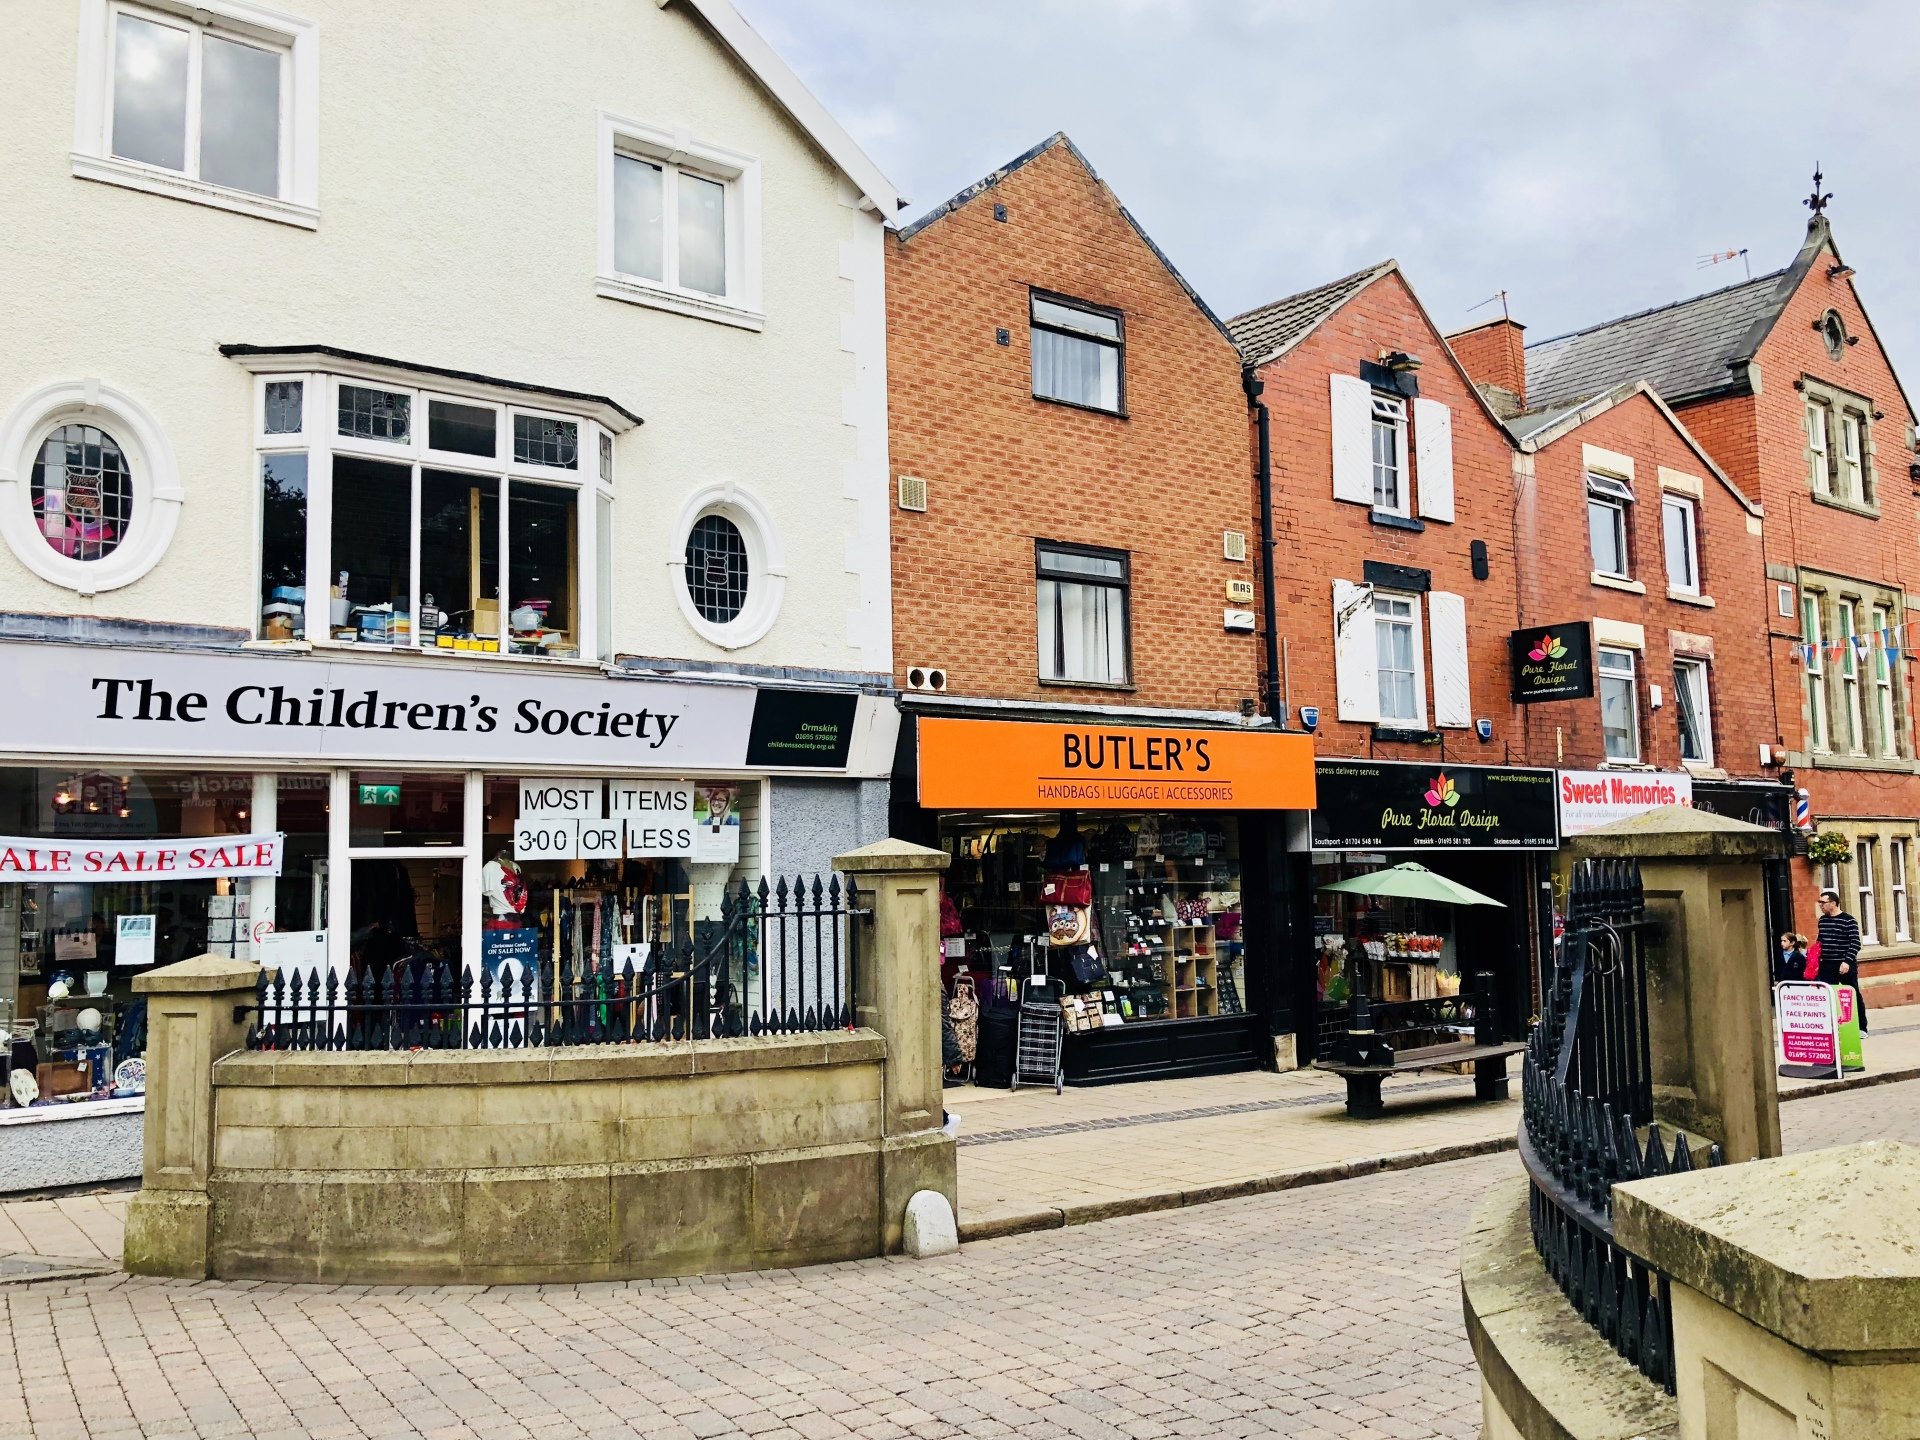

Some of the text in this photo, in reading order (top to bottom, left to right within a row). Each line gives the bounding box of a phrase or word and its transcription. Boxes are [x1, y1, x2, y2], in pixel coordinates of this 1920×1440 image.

[1522, 660, 1577, 676] Pure Floral
[1534, 674, 1566, 685] Design
[92, 679, 679, 748] The Children's Society
[801, 723, 838, 733] Ormskirk
[795, 733, 814, 741] 01695
[767, 741, 835, 751] childrenssociety.org.uk
[1064, 734, 1210, 771] BUTLER'S
[1336, 767, 1358, 777] delivery
[1360, 768, 1380, 776] service
[1038, 785, 1233, 800] HANDBAGS LUGGAGE ACCESSORIES
[1562, 776, 1675, 804] Sweet Memories
[524, 788, 687, 811] MOST ITEMS
[1382, 808, 1500, 831] Pure Floral Design
[583, 830, 617, 850] OR
[631, 829, 691, 849] LESS
[1315, 838, 1340, 846] Southport
[0, 843, 273, 872] ALE SALE SALE
[1790, 1022, 1824, 1030] BALLOONS
